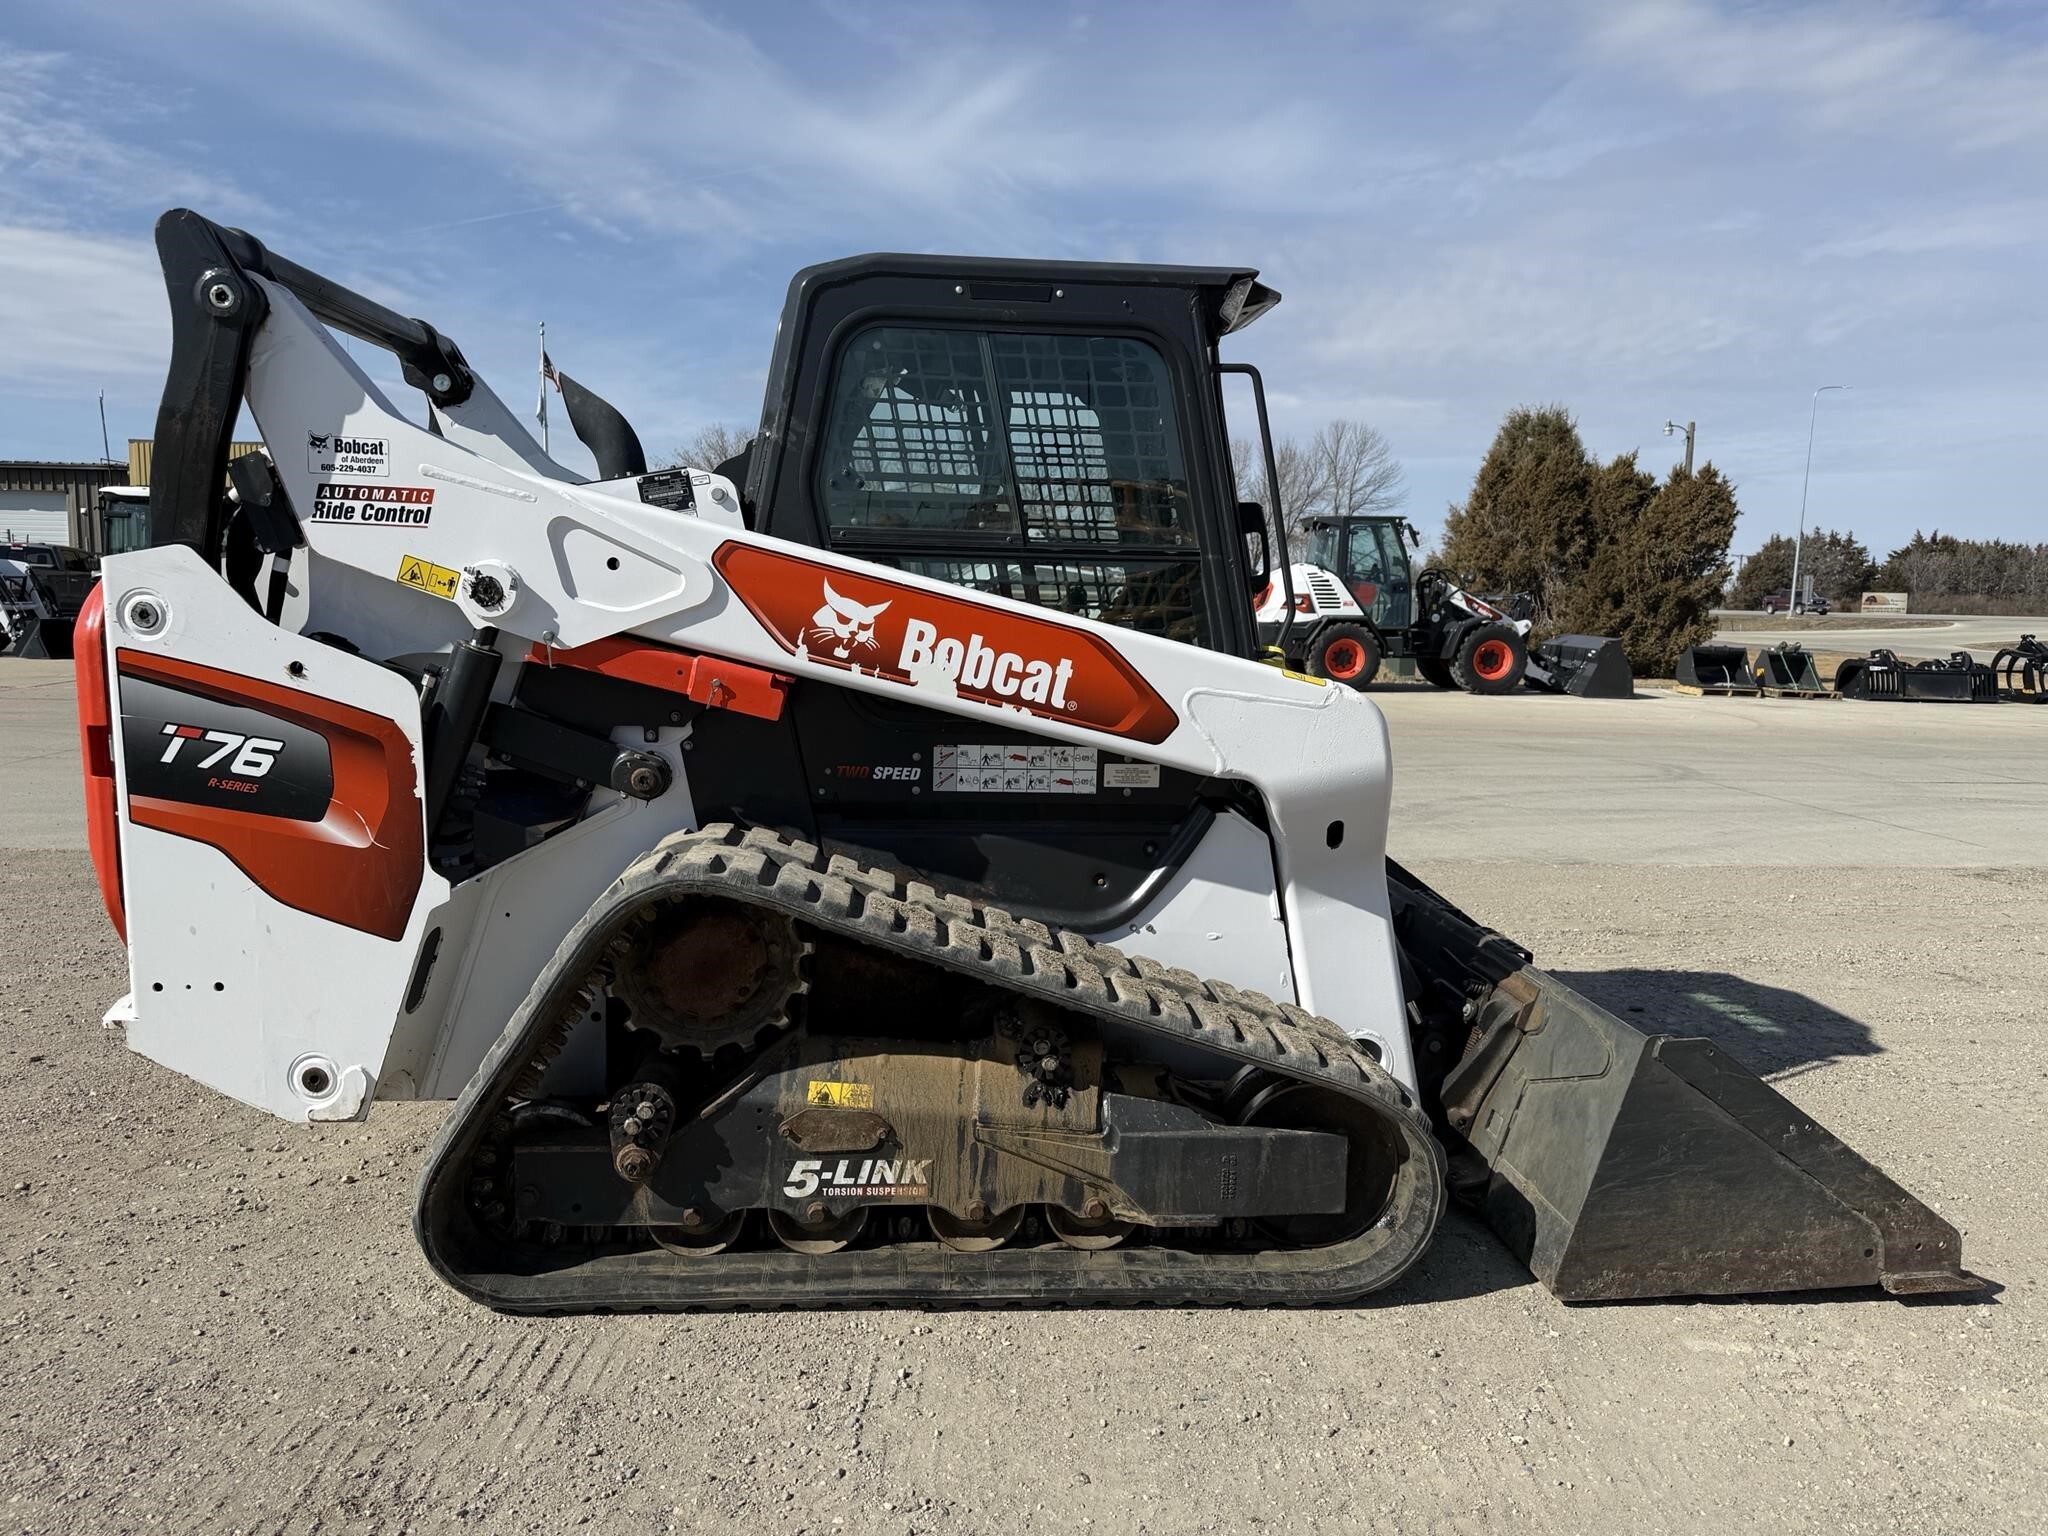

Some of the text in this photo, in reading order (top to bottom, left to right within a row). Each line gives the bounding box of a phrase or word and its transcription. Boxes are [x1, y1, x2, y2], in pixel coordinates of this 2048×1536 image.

[334, 438, 384, 455] Bobcat
[321, 463, 377, 474] 605-229-4037
[350, 456, 384, 465] Aberdeen
[320, 486, 430, 503] AUTOMATIC
[312, 501, 432, 524] Ride Control
[898, 618, 1073, 709] Bobcat
[160, 723, 285, 777] T76
[837, 765, 921, 781] TWO SPEED
[208, 778, 259, 793] R-SERIES
[783, 1159, 933, 1198] 5-LINK
[822, 1187, 863, 1197] TORSION
